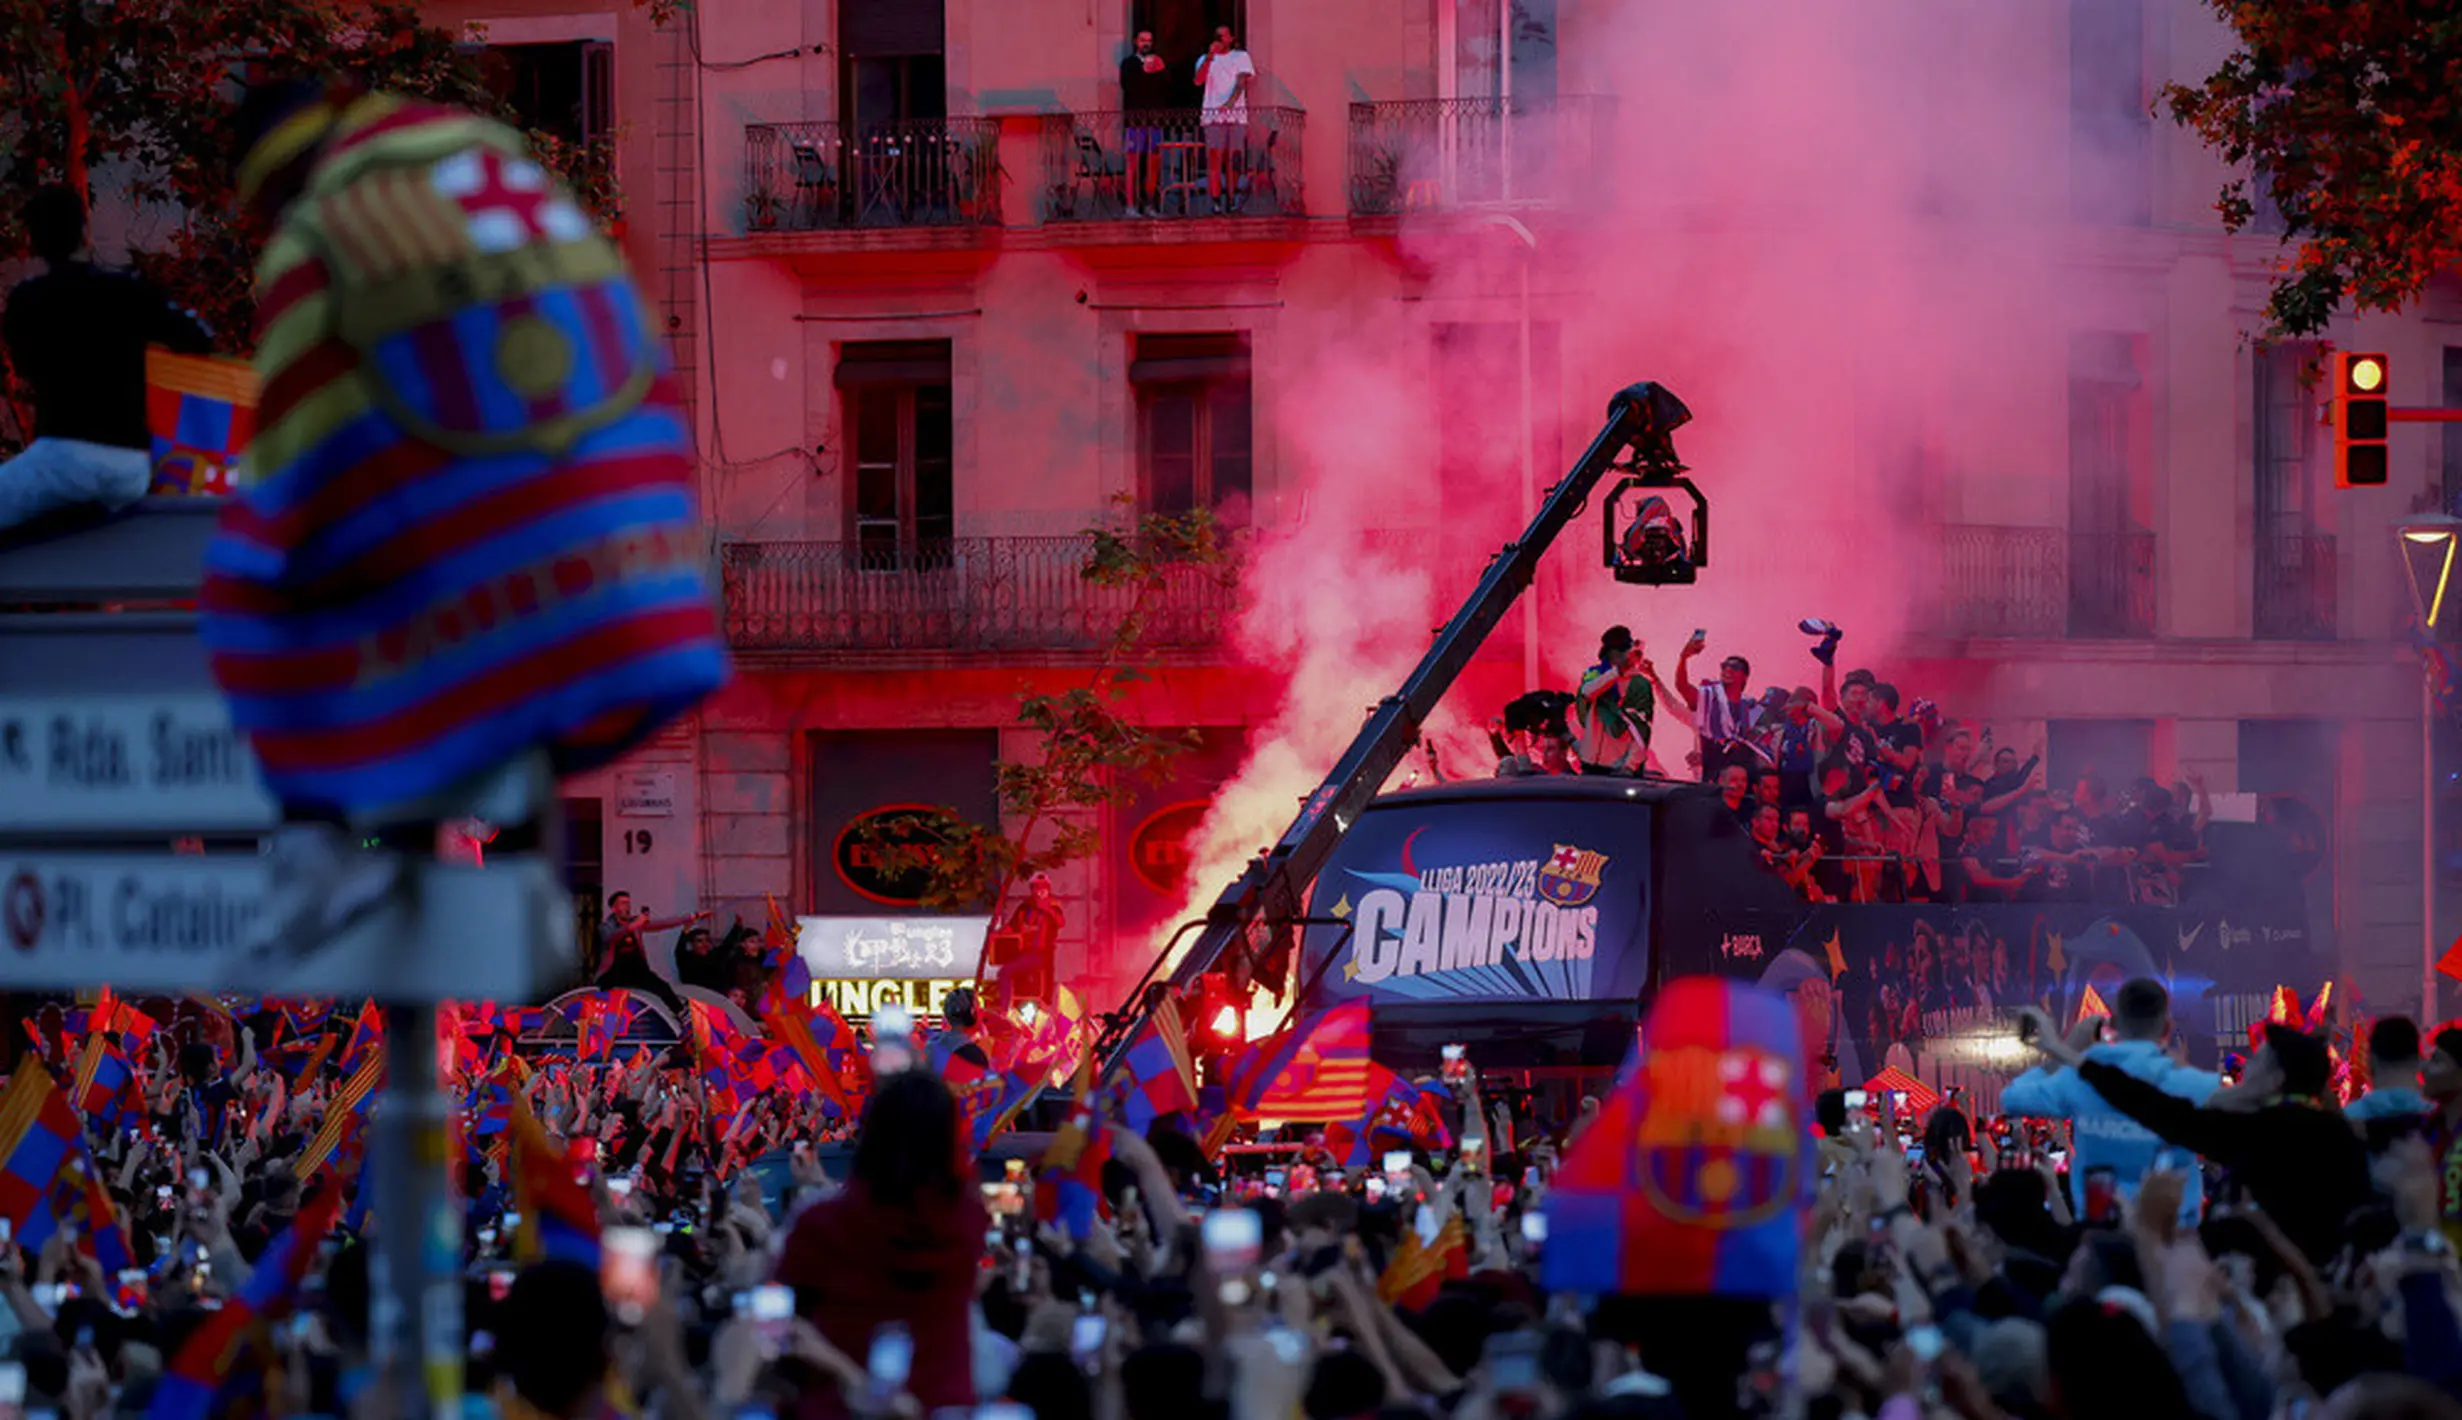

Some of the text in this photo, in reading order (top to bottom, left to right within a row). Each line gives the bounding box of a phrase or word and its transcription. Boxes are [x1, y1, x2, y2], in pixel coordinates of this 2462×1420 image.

[624, 829, 652, 854] 19
[1421, 860, 1538, 899] LLIGA 2022/23
[1353, 889, 1598, 983] CAMPIONS
